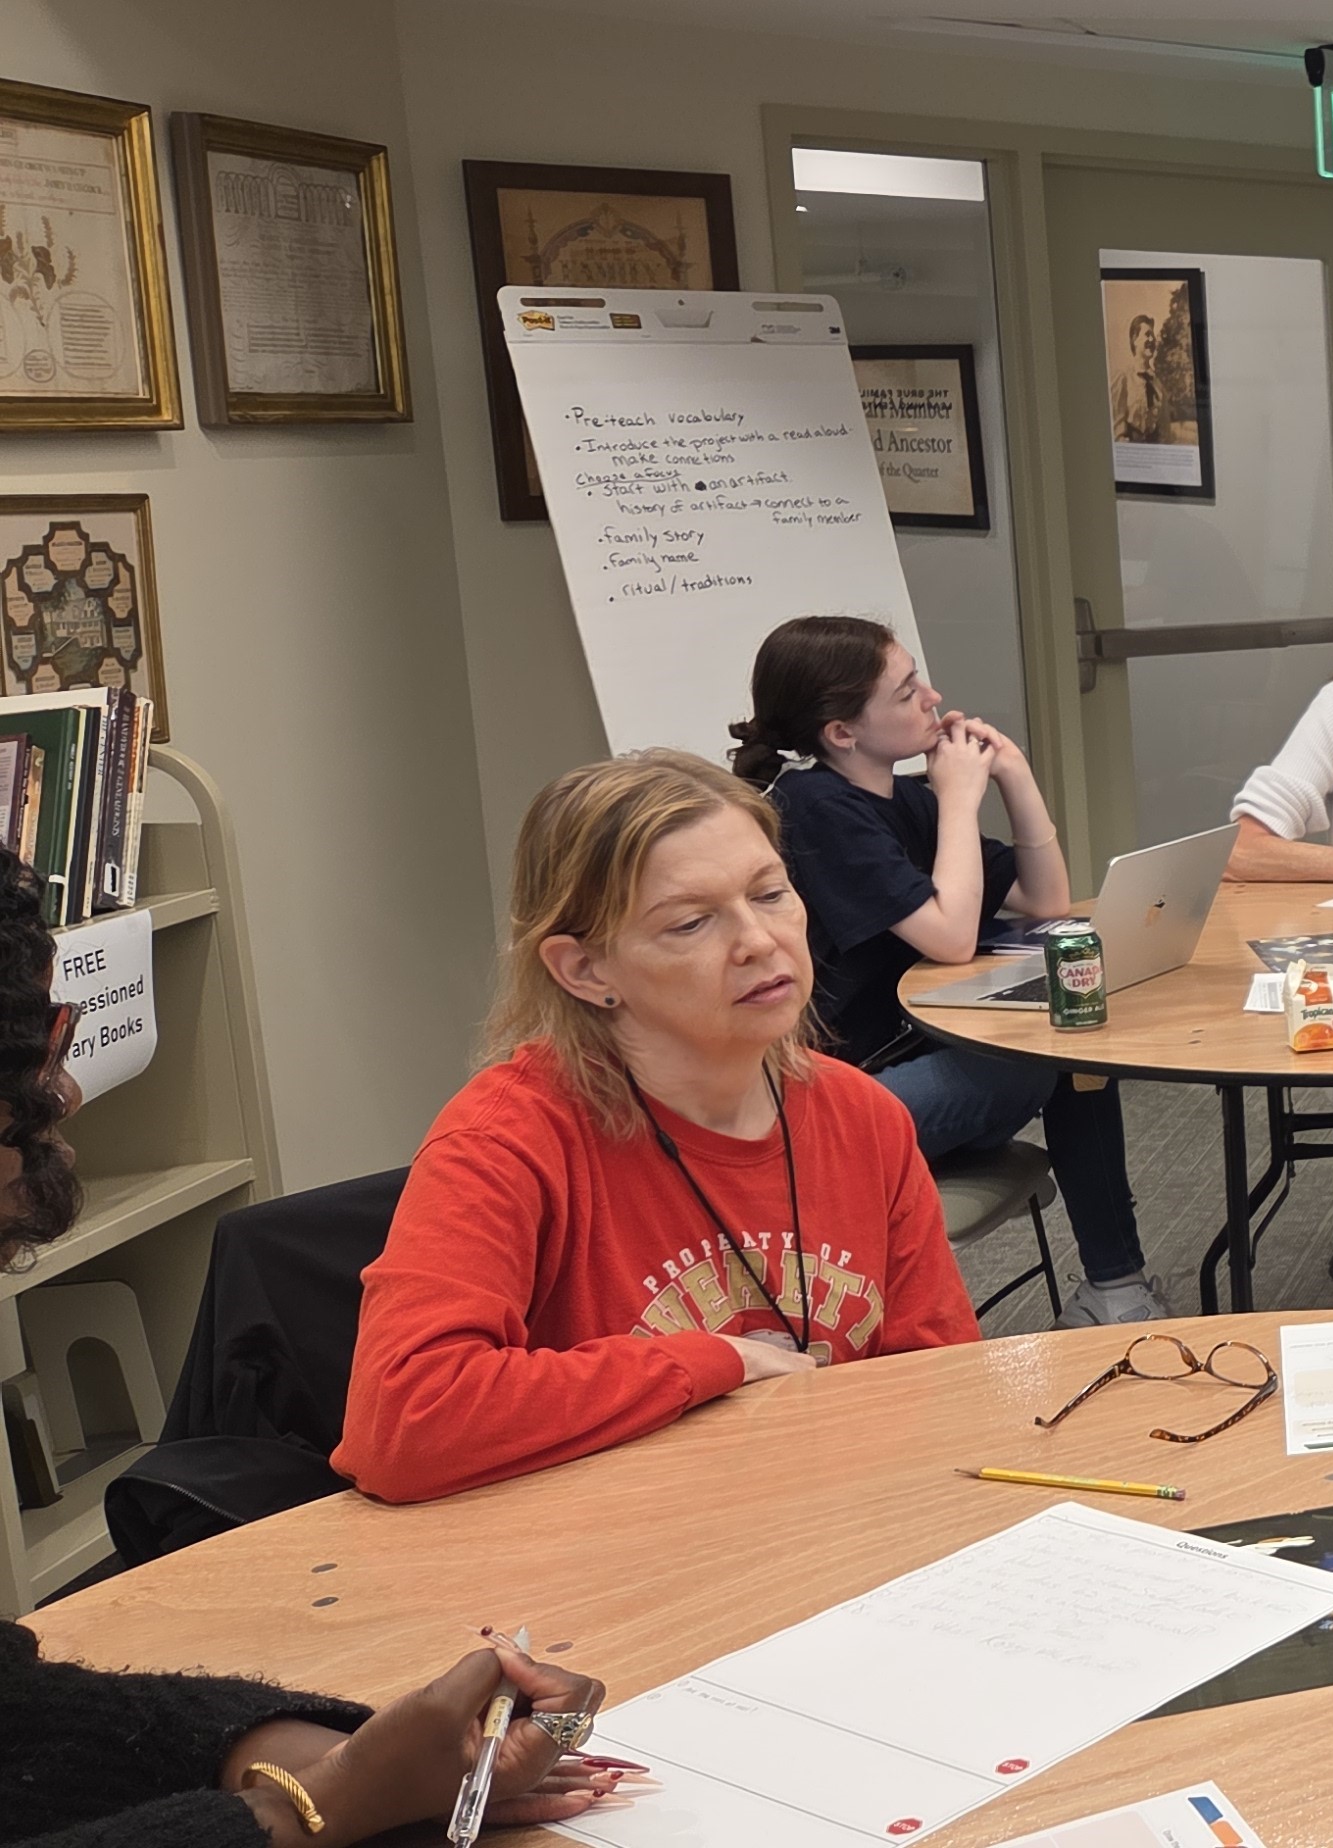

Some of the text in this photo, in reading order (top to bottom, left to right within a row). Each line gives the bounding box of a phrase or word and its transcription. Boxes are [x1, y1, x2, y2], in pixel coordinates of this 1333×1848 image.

[668, 407, 744, 427] vocabulary
[581, 438, 658, 453] Introduce
[662, 434, 687, 449] the
[689, 433, 738, 452] project
[887, 431, 953, 453] Ancestor
[611, 453, 659, 467] make
[653, 479, 691, 494] with
[615, 499, 666, 518] history
[772, 510, 813, 528] family
[603, 525, 658, 549] family
[608, 551, 700, 574] family name
[62, 948, 107, 981] FREE
[1071, 977, 1097, 988] DRY
[80, 974, 144, 1016] essioned
[1062, 1005, 1093, 1015] GINGER
[99, 1016, 143, 1048] Books
[642, 1230, 852, 1295] PROPERTY OF
[1175, 1540, 1230, 1560] Questions
